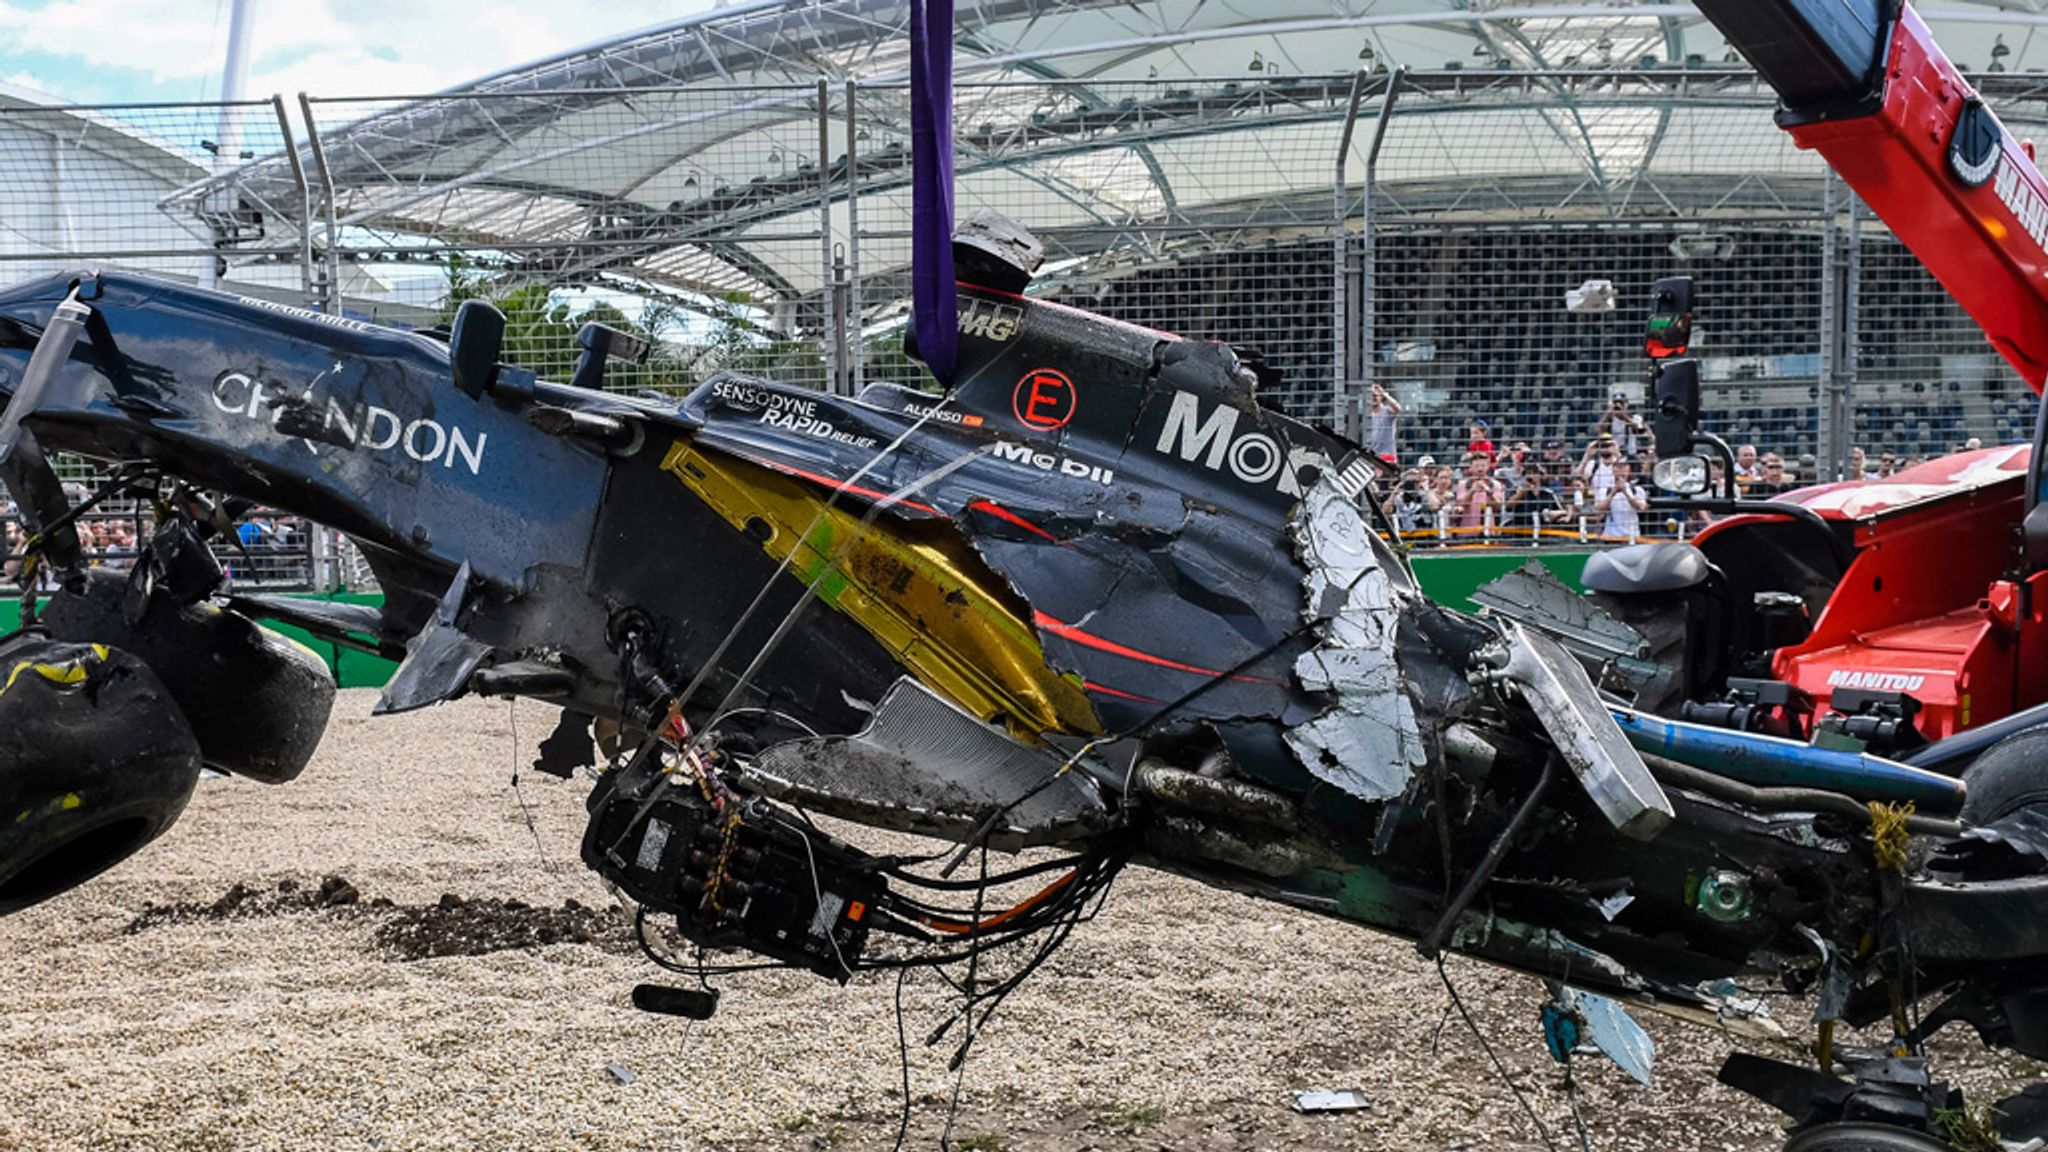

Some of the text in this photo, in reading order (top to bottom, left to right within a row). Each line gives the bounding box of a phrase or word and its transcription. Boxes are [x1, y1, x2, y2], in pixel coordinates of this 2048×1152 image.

[239, 296, 368, 332] RICHARD MILLE
[712, 381, 818, 418] SENSODYNE
[903, 403, 962, 423] ALONSO
[1025, 375, 1065, 427] E
[760, 408, 877, 449] RAPID RELIEF
[1827, 669, 1926, 692] MANITOU
